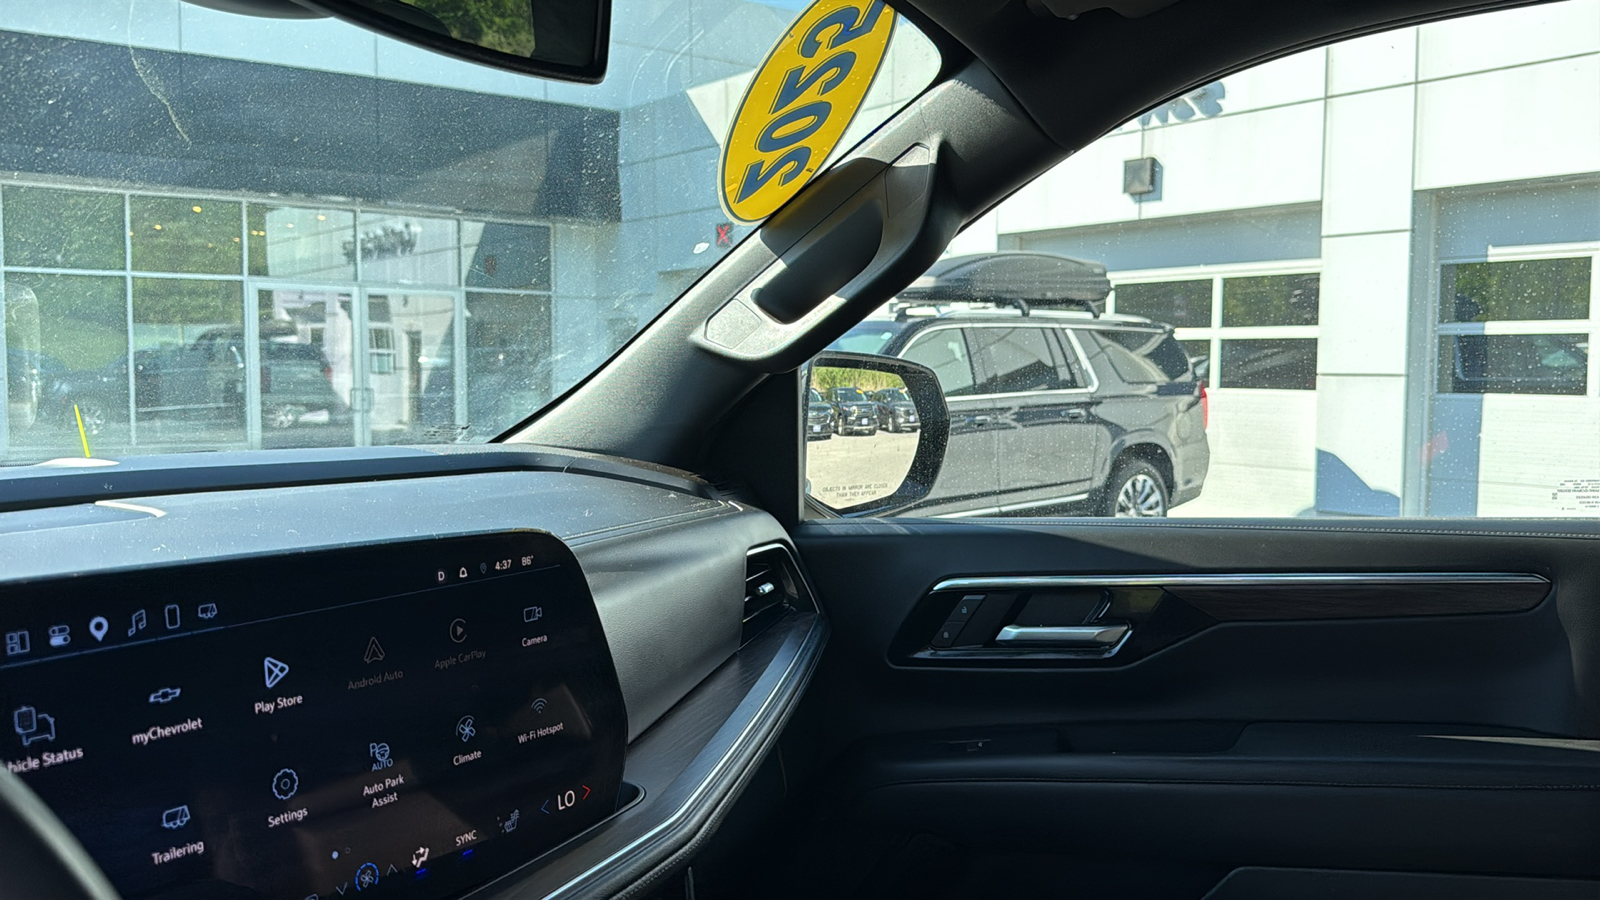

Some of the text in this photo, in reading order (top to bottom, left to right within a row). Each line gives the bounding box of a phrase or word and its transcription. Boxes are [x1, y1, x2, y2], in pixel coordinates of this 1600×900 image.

[495, 559, 512, 570] 4:37
[437, 571, 445, 581] D
[522, 635, 548, 647] Camera
[434, 650, 487, 670] Apple CarPlay
[348, 670, 404, 690] Android Auto
[254, 695, 303, 714] Play Store
[131, 717, 203, 745] myChevrolet
[517, 722, 564, 744] Wi-Fi Hotspot
[6, 747, 84, 774] hicle Status
[371, 758, 394, 772] AUTO
[453, 750, 482, 766] Climate
[363, 774, 405, 796] Auto Park
[371, 792, 398, 808] Assist
[557, 790, 576, 811] LO
[267, 807, 309, 828] Settings
[455, 829, 477, 847] SYNC
[151, 841, 205, 866] Trailering
